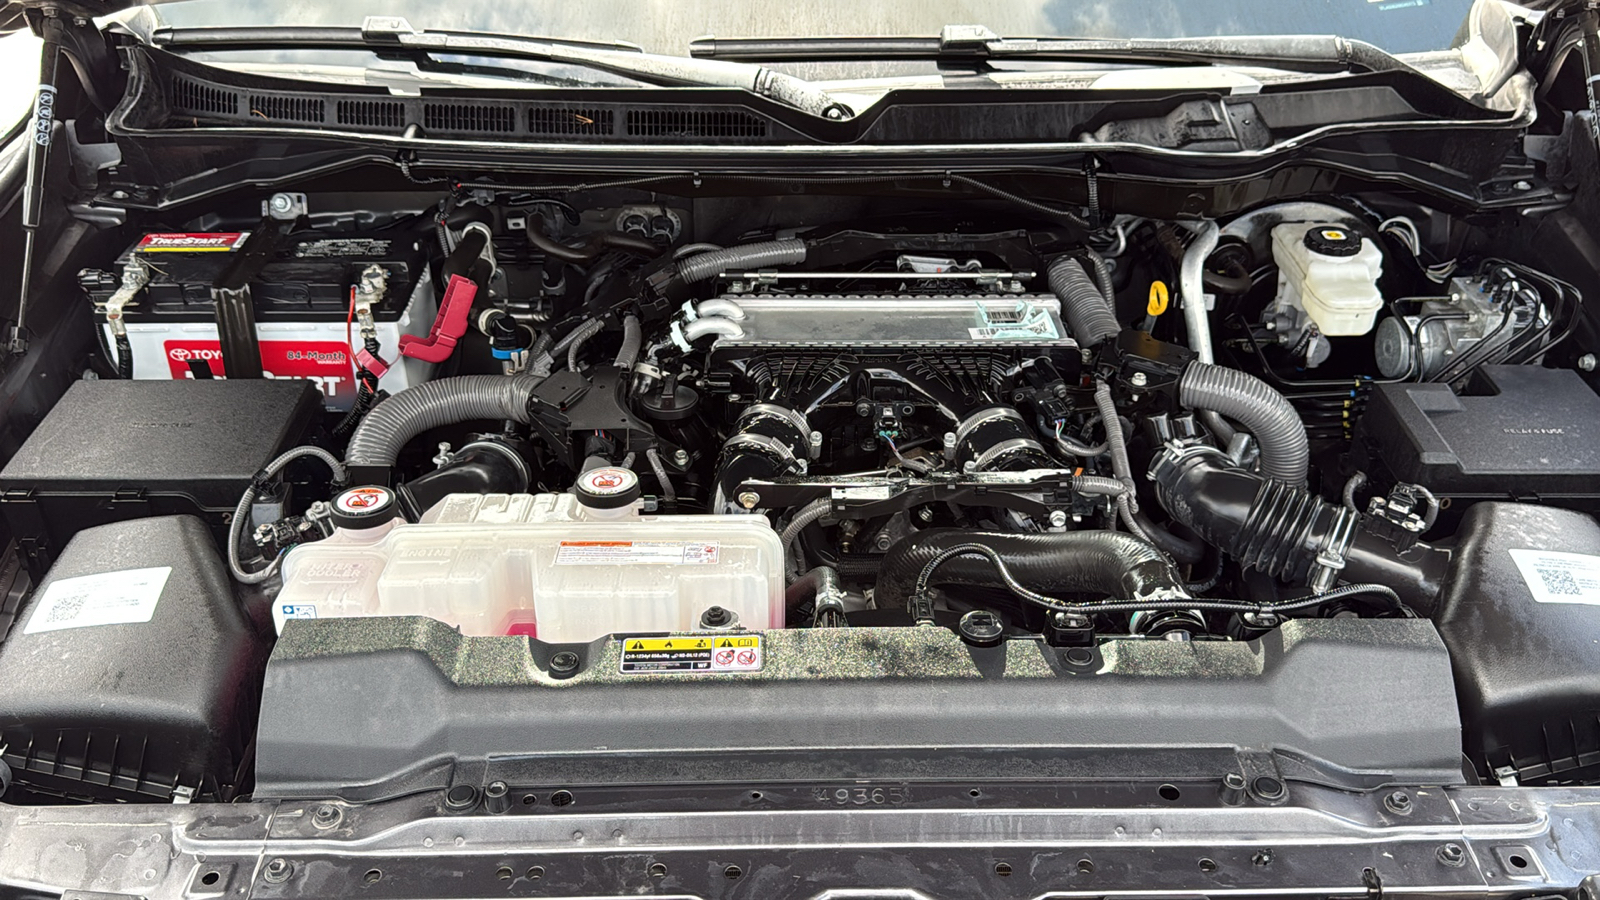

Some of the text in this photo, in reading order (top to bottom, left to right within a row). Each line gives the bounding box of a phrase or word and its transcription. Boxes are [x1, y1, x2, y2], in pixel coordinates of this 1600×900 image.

[150, 237, 227, 245] TRUESTART
[191, 351, 223, 360] TOY
[287, 351, 346, 360] 84-Month
